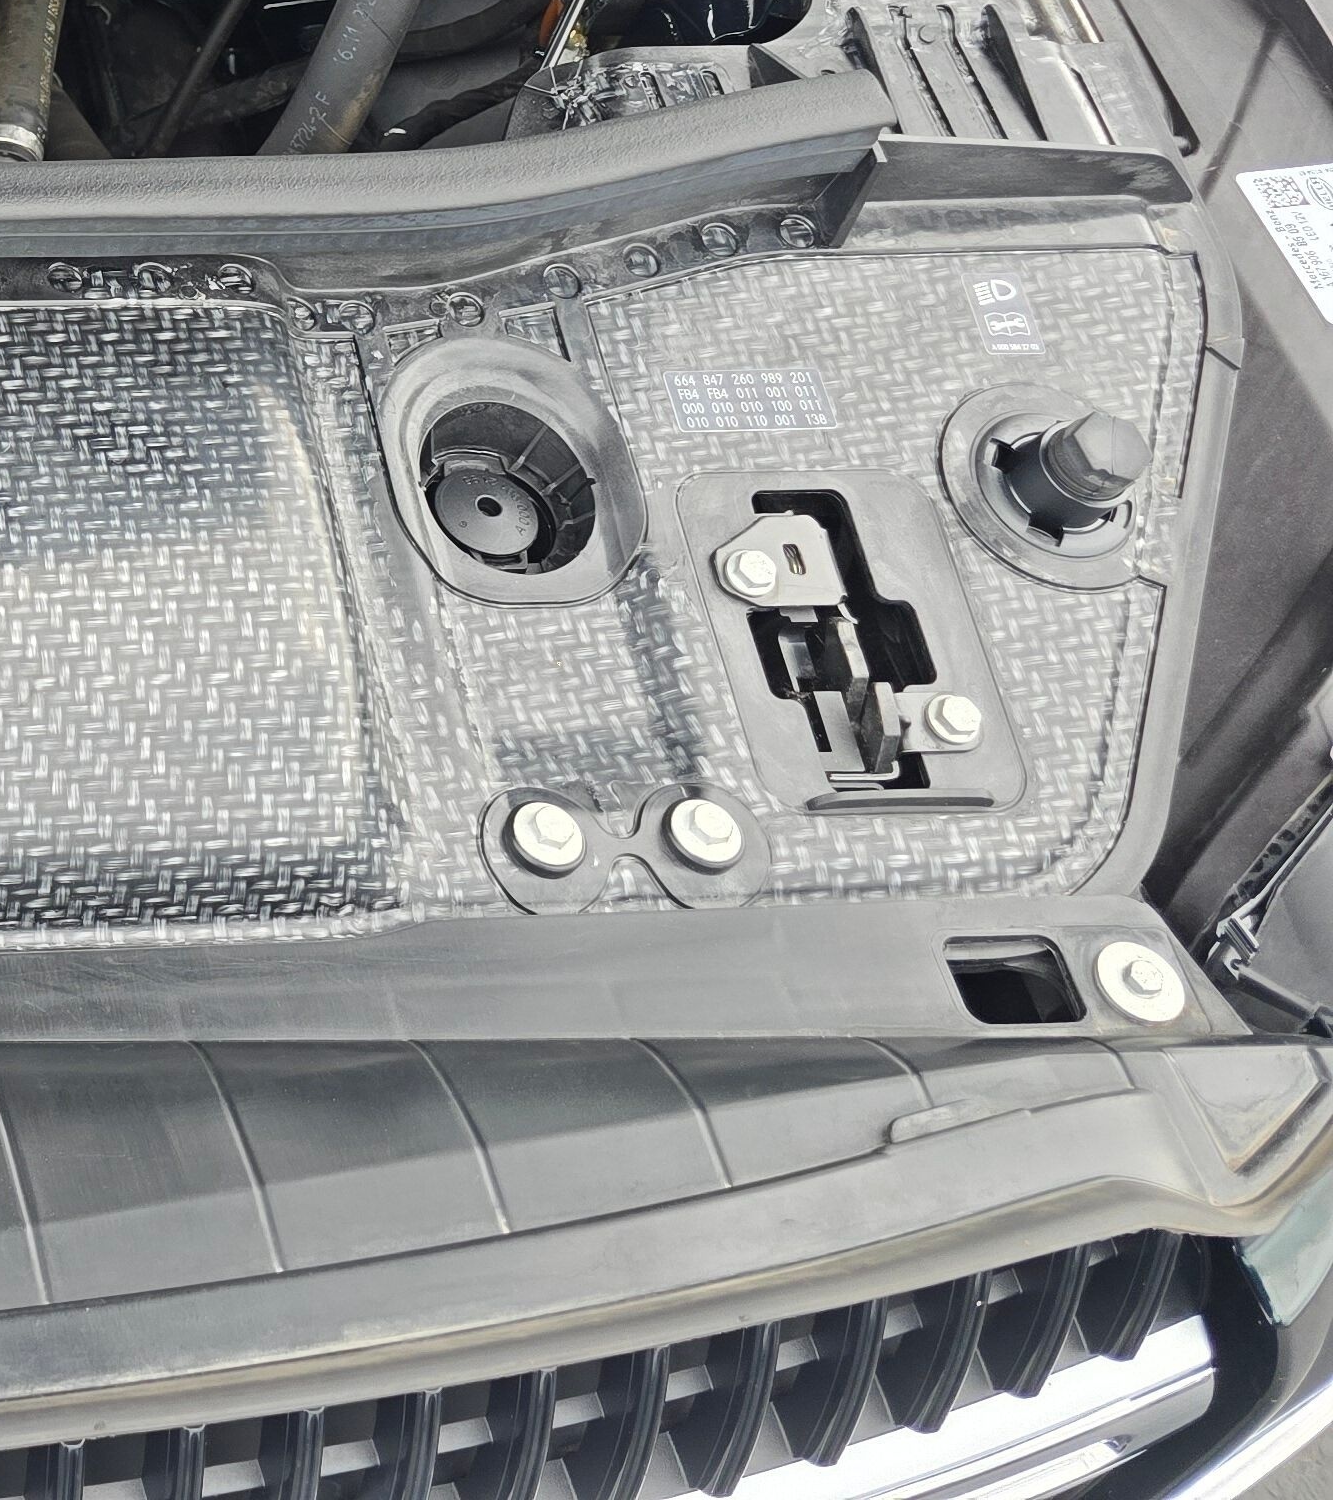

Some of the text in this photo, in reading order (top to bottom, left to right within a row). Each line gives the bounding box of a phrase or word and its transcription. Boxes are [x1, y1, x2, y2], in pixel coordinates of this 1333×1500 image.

[1265, 209, 1287, 233] Benz
[1287, 242, 1324, 289] Mercedes
[1304, 250, 1323, 266] 906
[674, 371, 813, 387] 664 847 260 989 201
[677, 385, 816, 400] FB4 FB4 011 001 011
[682, 399, 822, 414] 000 010 010 100 011
[686, 413, 828, 428] 010 010 110 001 138
